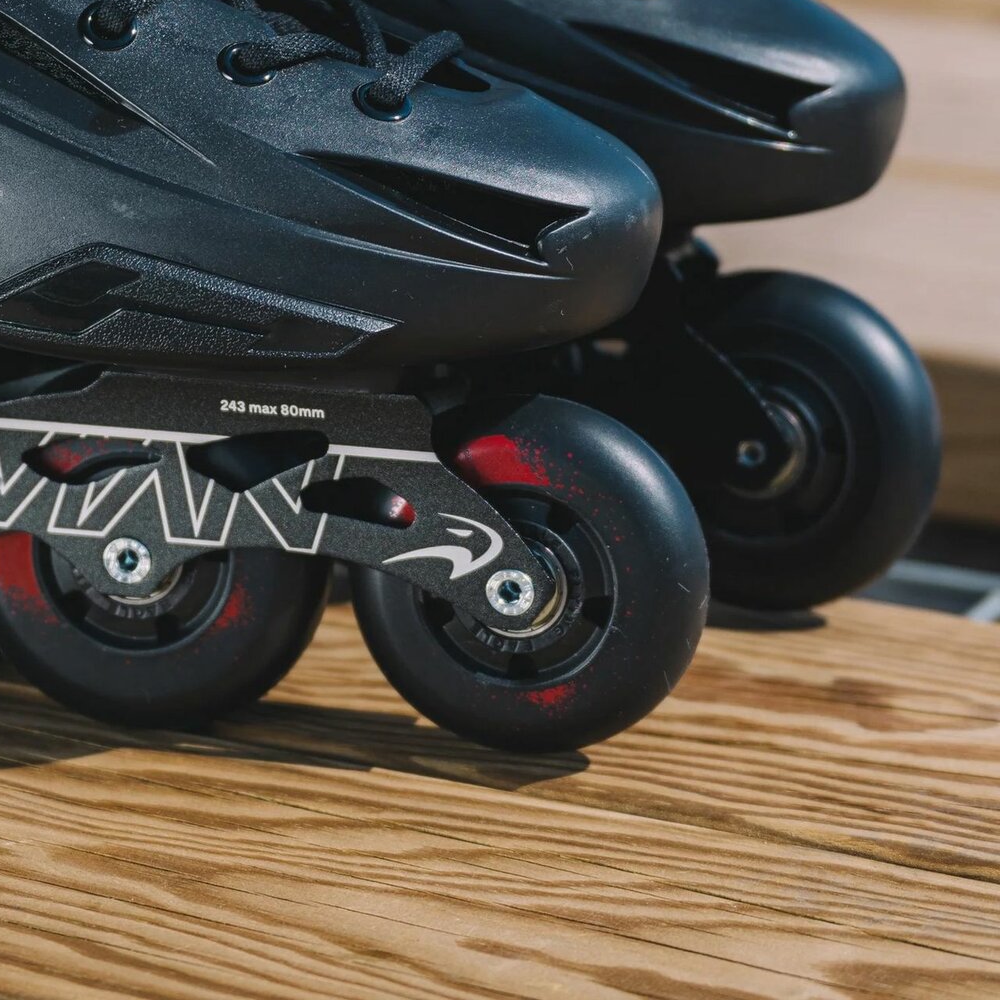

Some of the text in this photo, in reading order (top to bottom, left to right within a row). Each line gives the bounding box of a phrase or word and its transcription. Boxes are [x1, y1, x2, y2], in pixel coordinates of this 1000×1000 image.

[220, 399, 325, 419] 243 max 80mm
